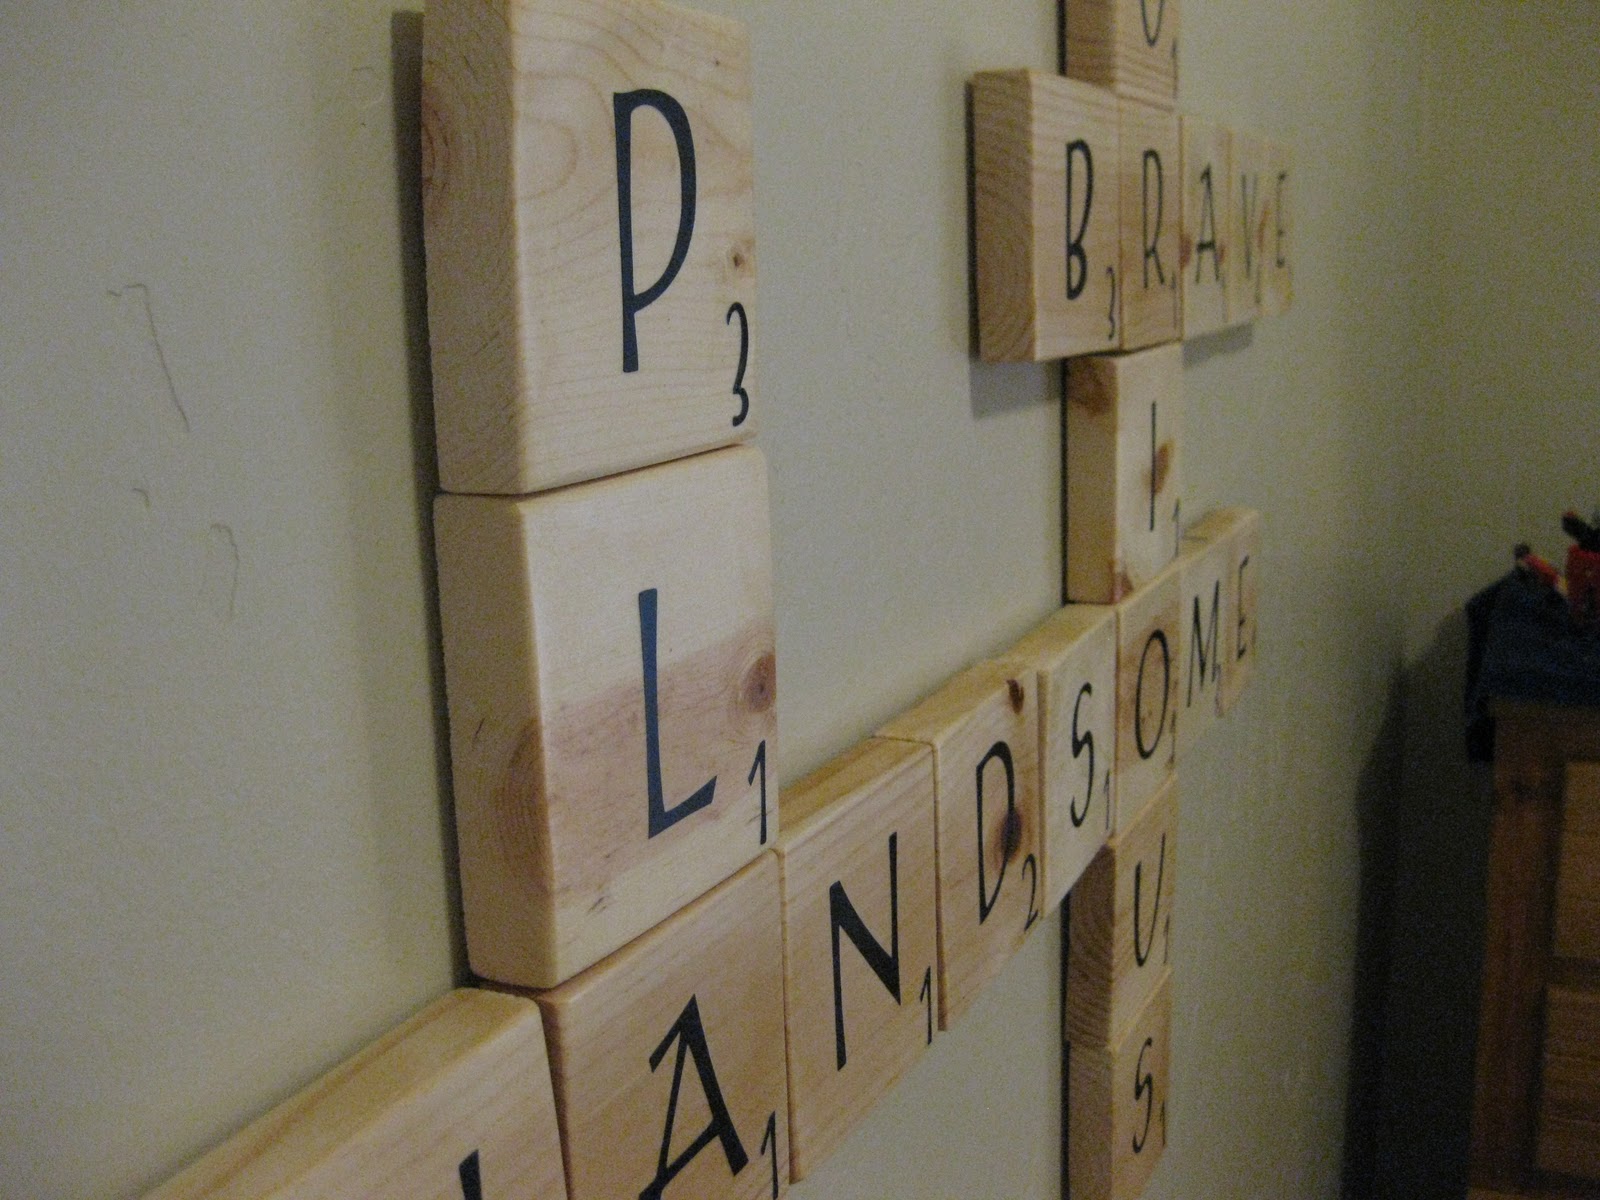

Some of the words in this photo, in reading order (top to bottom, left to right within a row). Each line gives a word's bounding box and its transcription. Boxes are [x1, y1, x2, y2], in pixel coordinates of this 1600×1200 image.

[613, 89, 697, 373] P
[726, 301, 750, 427] 3
[638, 587, 718, 839] L
[748, 739, 767, 846] 1
[1021, 853, 1039, 933] 2
[919, 965, 933, 1046] 1
[760, 1110, 780, 1200] 1
